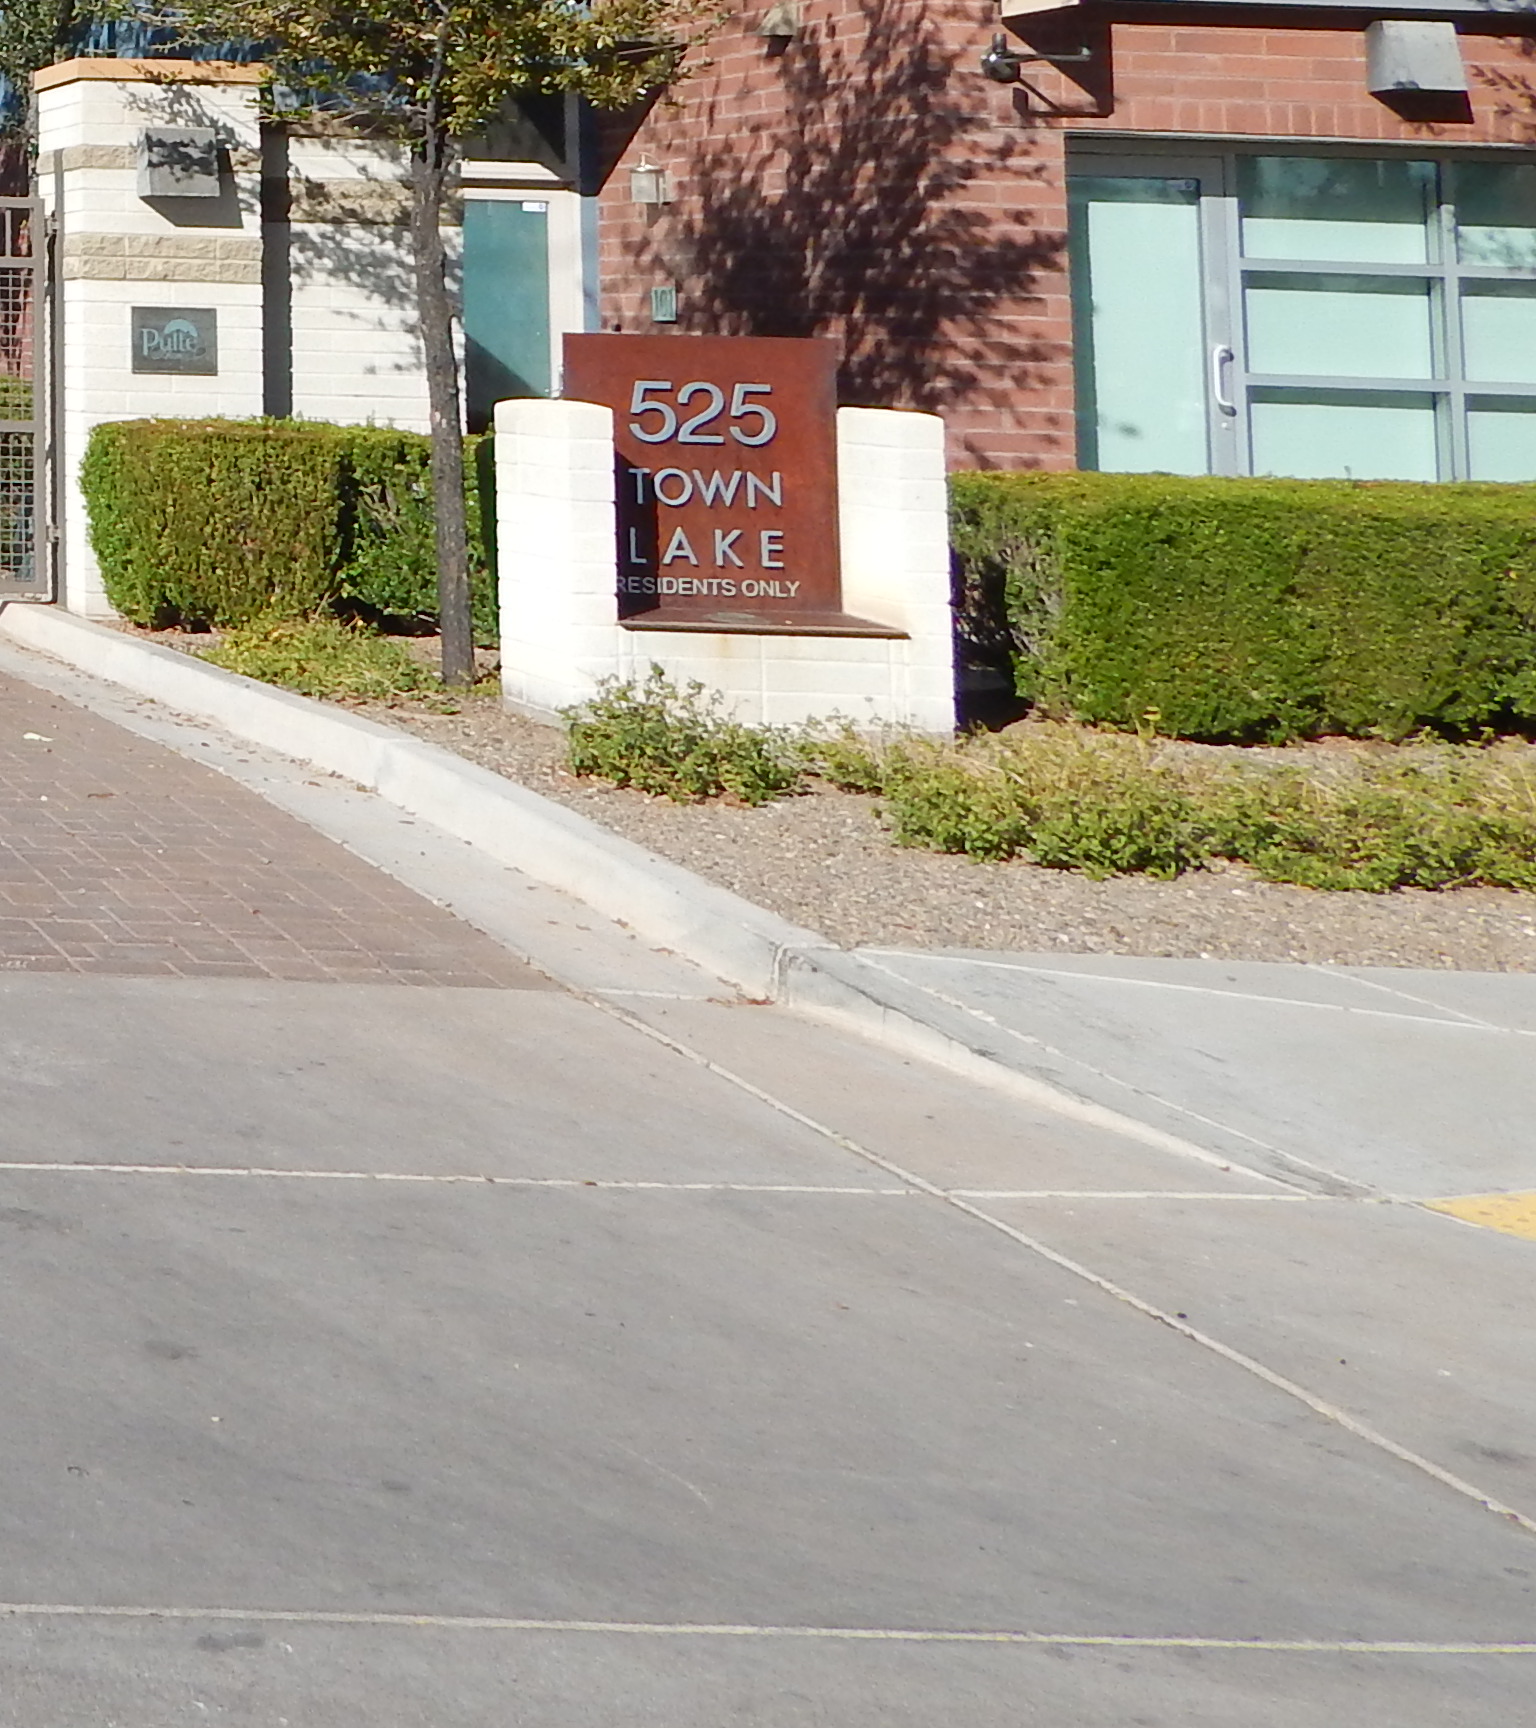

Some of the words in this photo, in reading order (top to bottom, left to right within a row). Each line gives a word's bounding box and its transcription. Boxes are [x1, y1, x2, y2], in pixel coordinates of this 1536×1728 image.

[141, 328, 197, 356] Pulte
[629, 380, 777, 446] 525
[628, 467, 782, 509] TOWN
[630, 526, 785, 568] LAKE
[616, 576, 737, 597] RESIDENTS
[741, 579, 800, 598] ONLY
